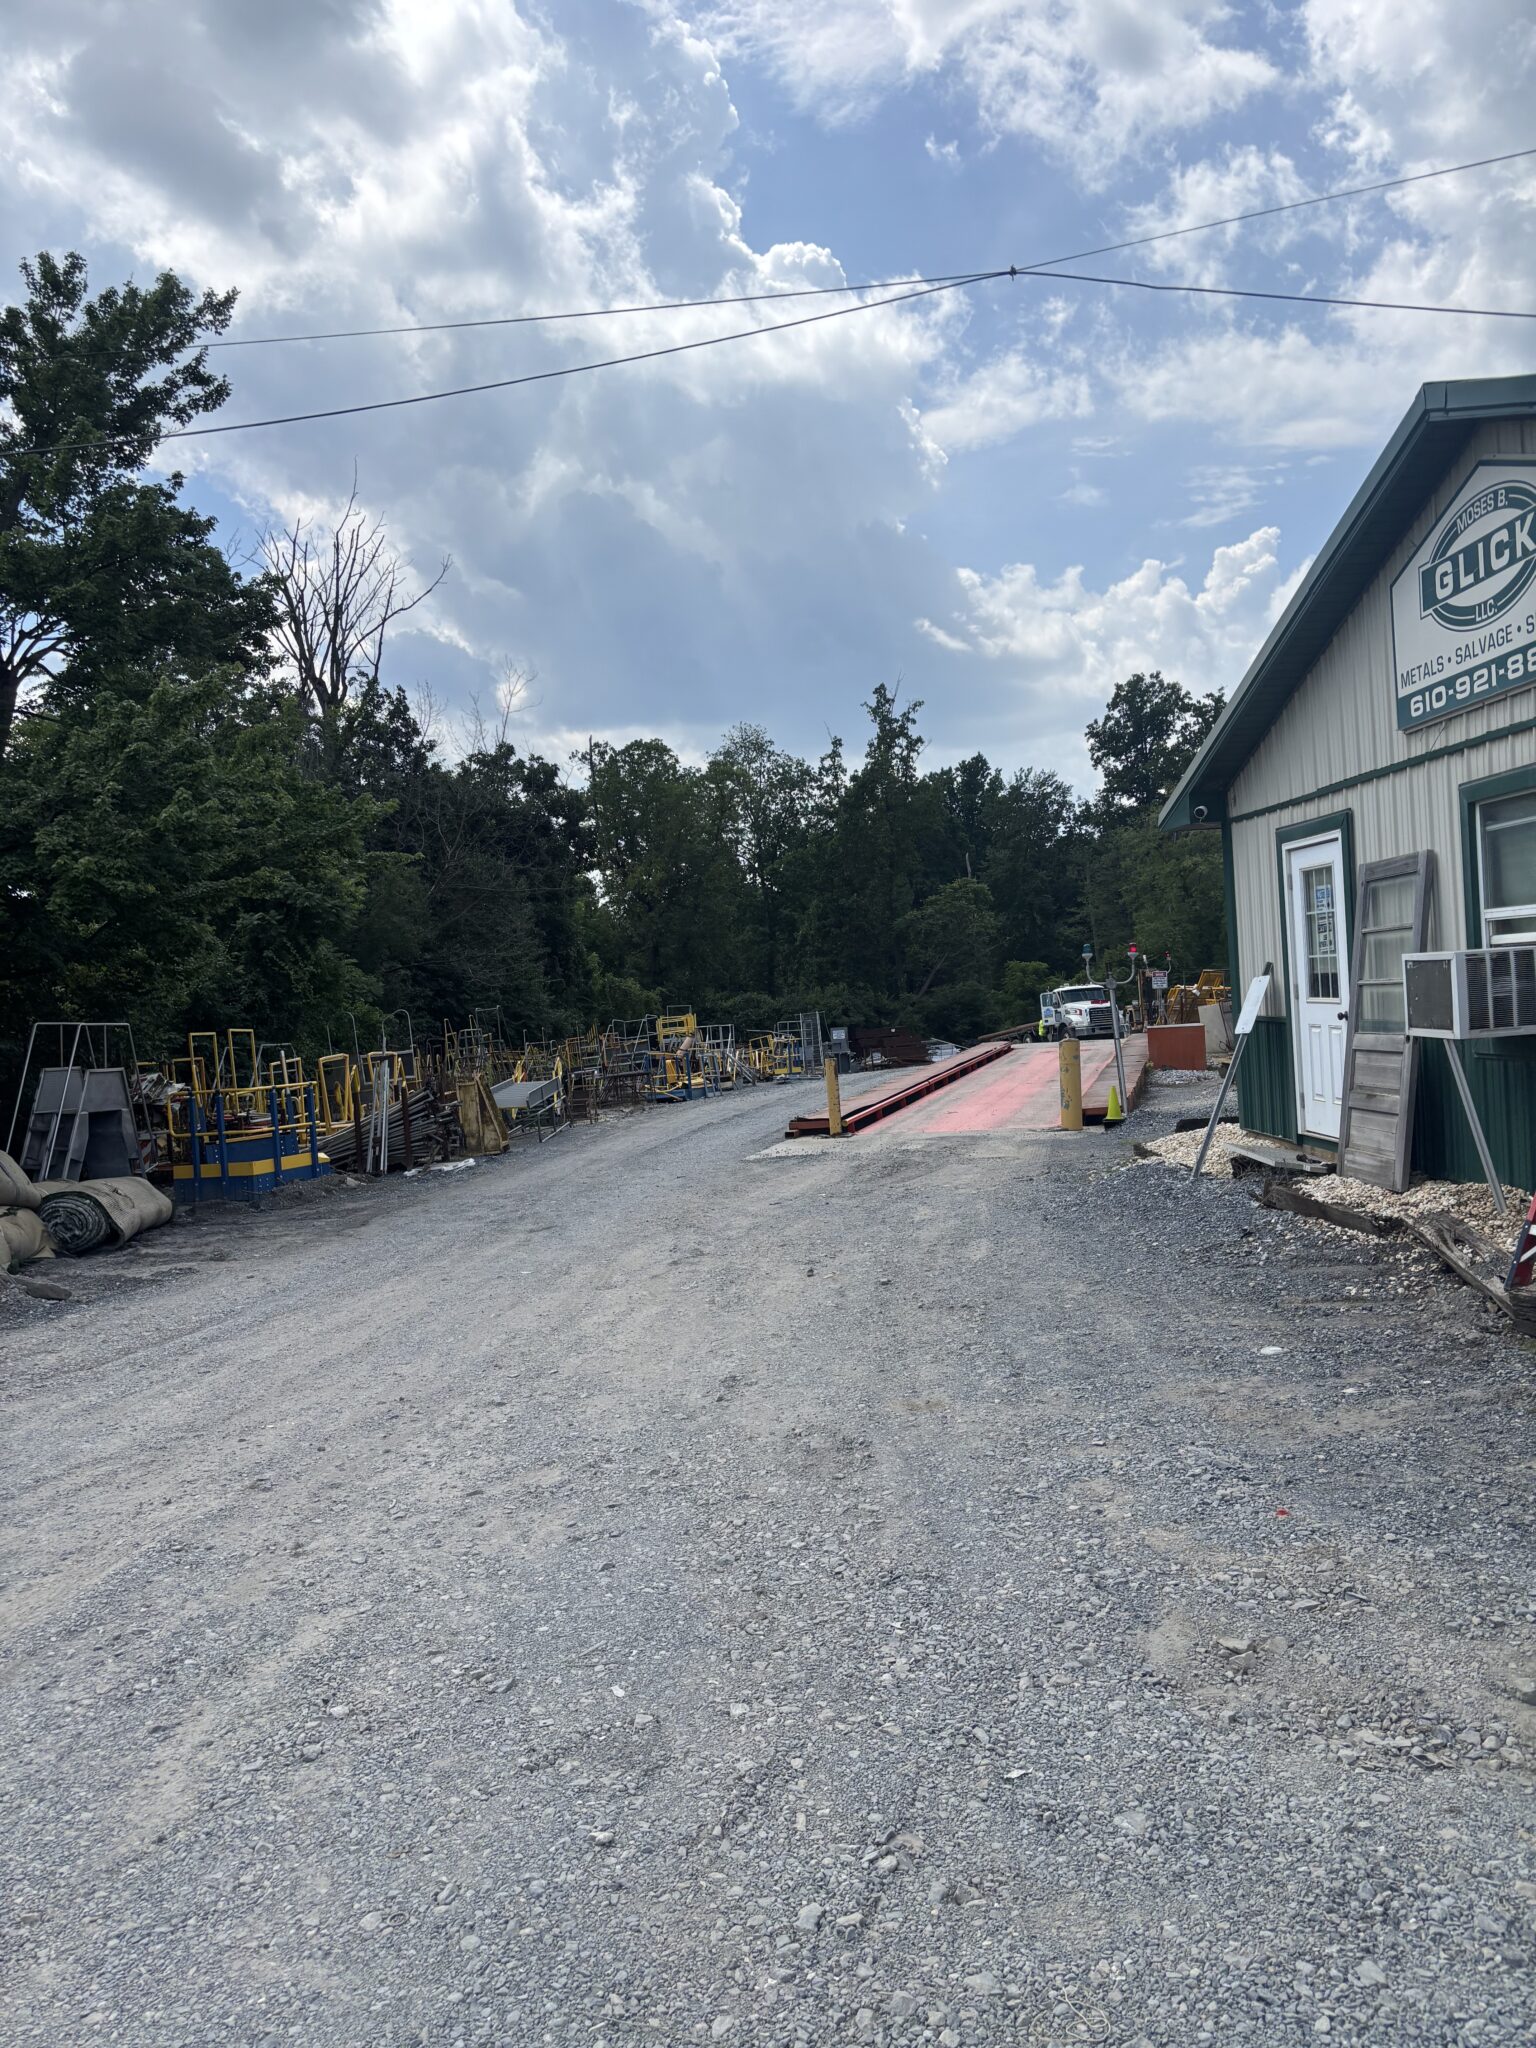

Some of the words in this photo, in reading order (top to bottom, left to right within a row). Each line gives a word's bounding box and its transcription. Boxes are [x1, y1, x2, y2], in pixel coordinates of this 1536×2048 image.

[1456, 493, 1495, 534] MOSES
[1497, 489, 1508, 507] B.
[1435, 511, 1536, 600] GLICK
[1475, 599, 1498, 622] LLC.
[1400, 655, 1445, 690] METALS
[1455, 623, 1513, 666] SALVAGE
[1526, 614, 1536, 634] S
